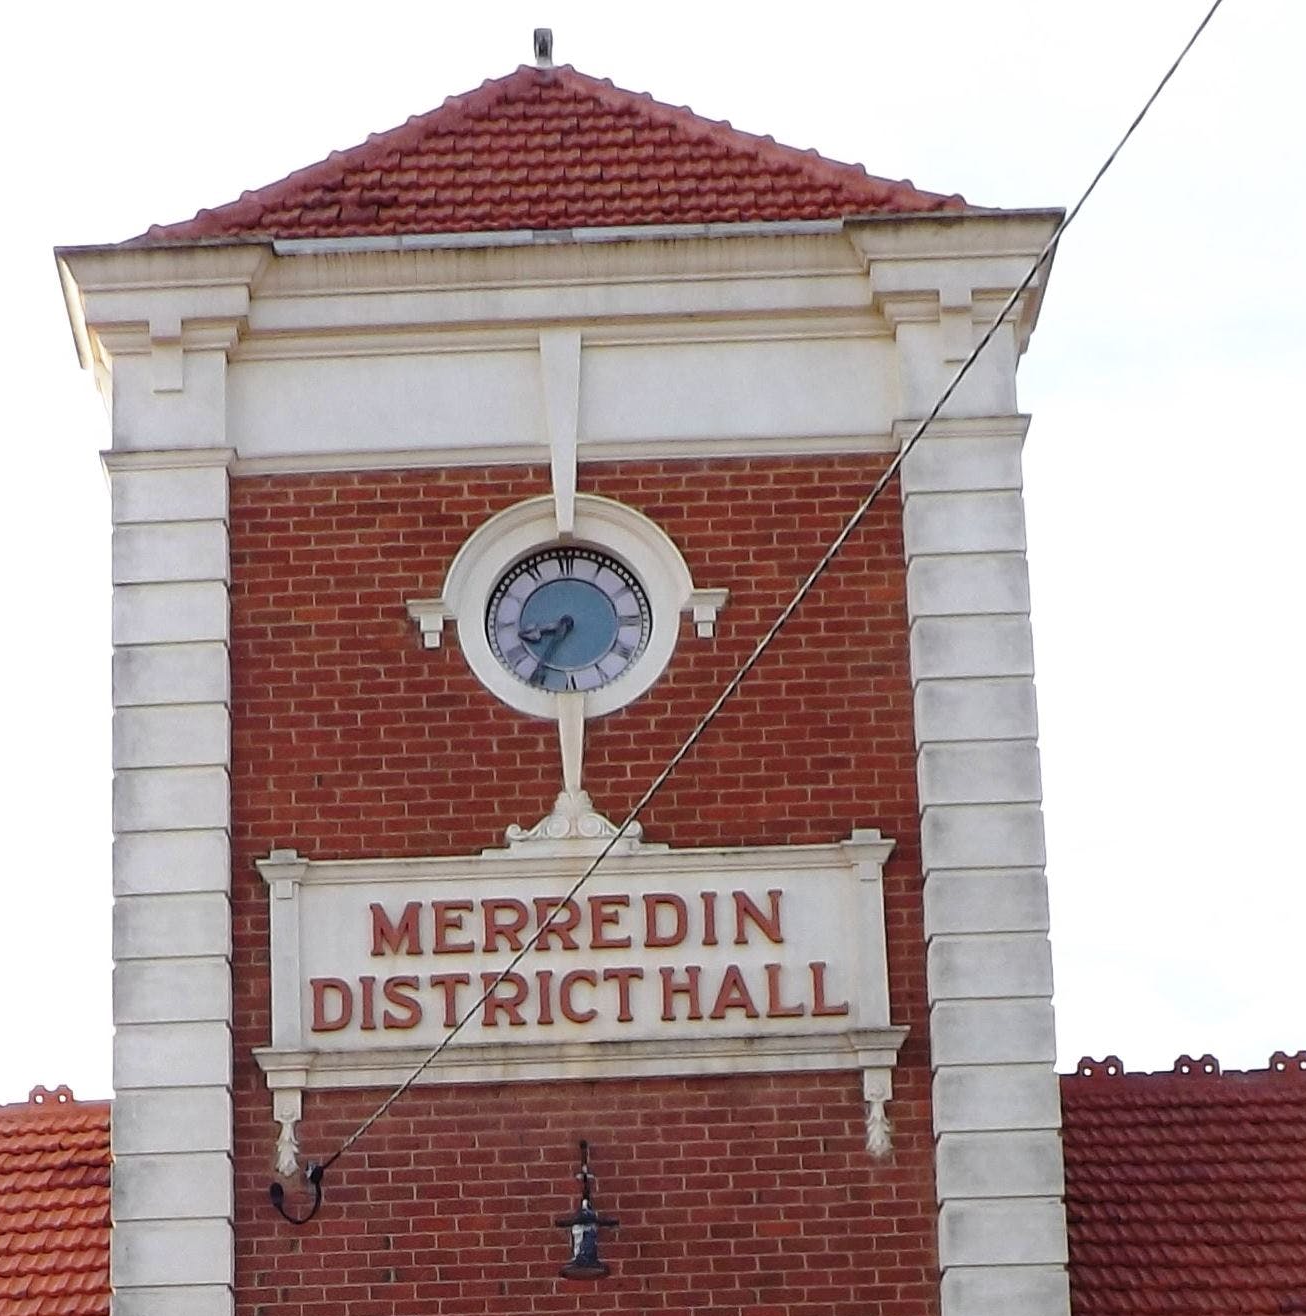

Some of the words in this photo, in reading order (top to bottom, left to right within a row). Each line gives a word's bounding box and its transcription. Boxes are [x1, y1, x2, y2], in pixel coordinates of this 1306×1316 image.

[369, 889, 784, 956] MERREDIN
[310, 966, 644, 1032] DISTRICT
[659, 961, 850, 1021] HALL
